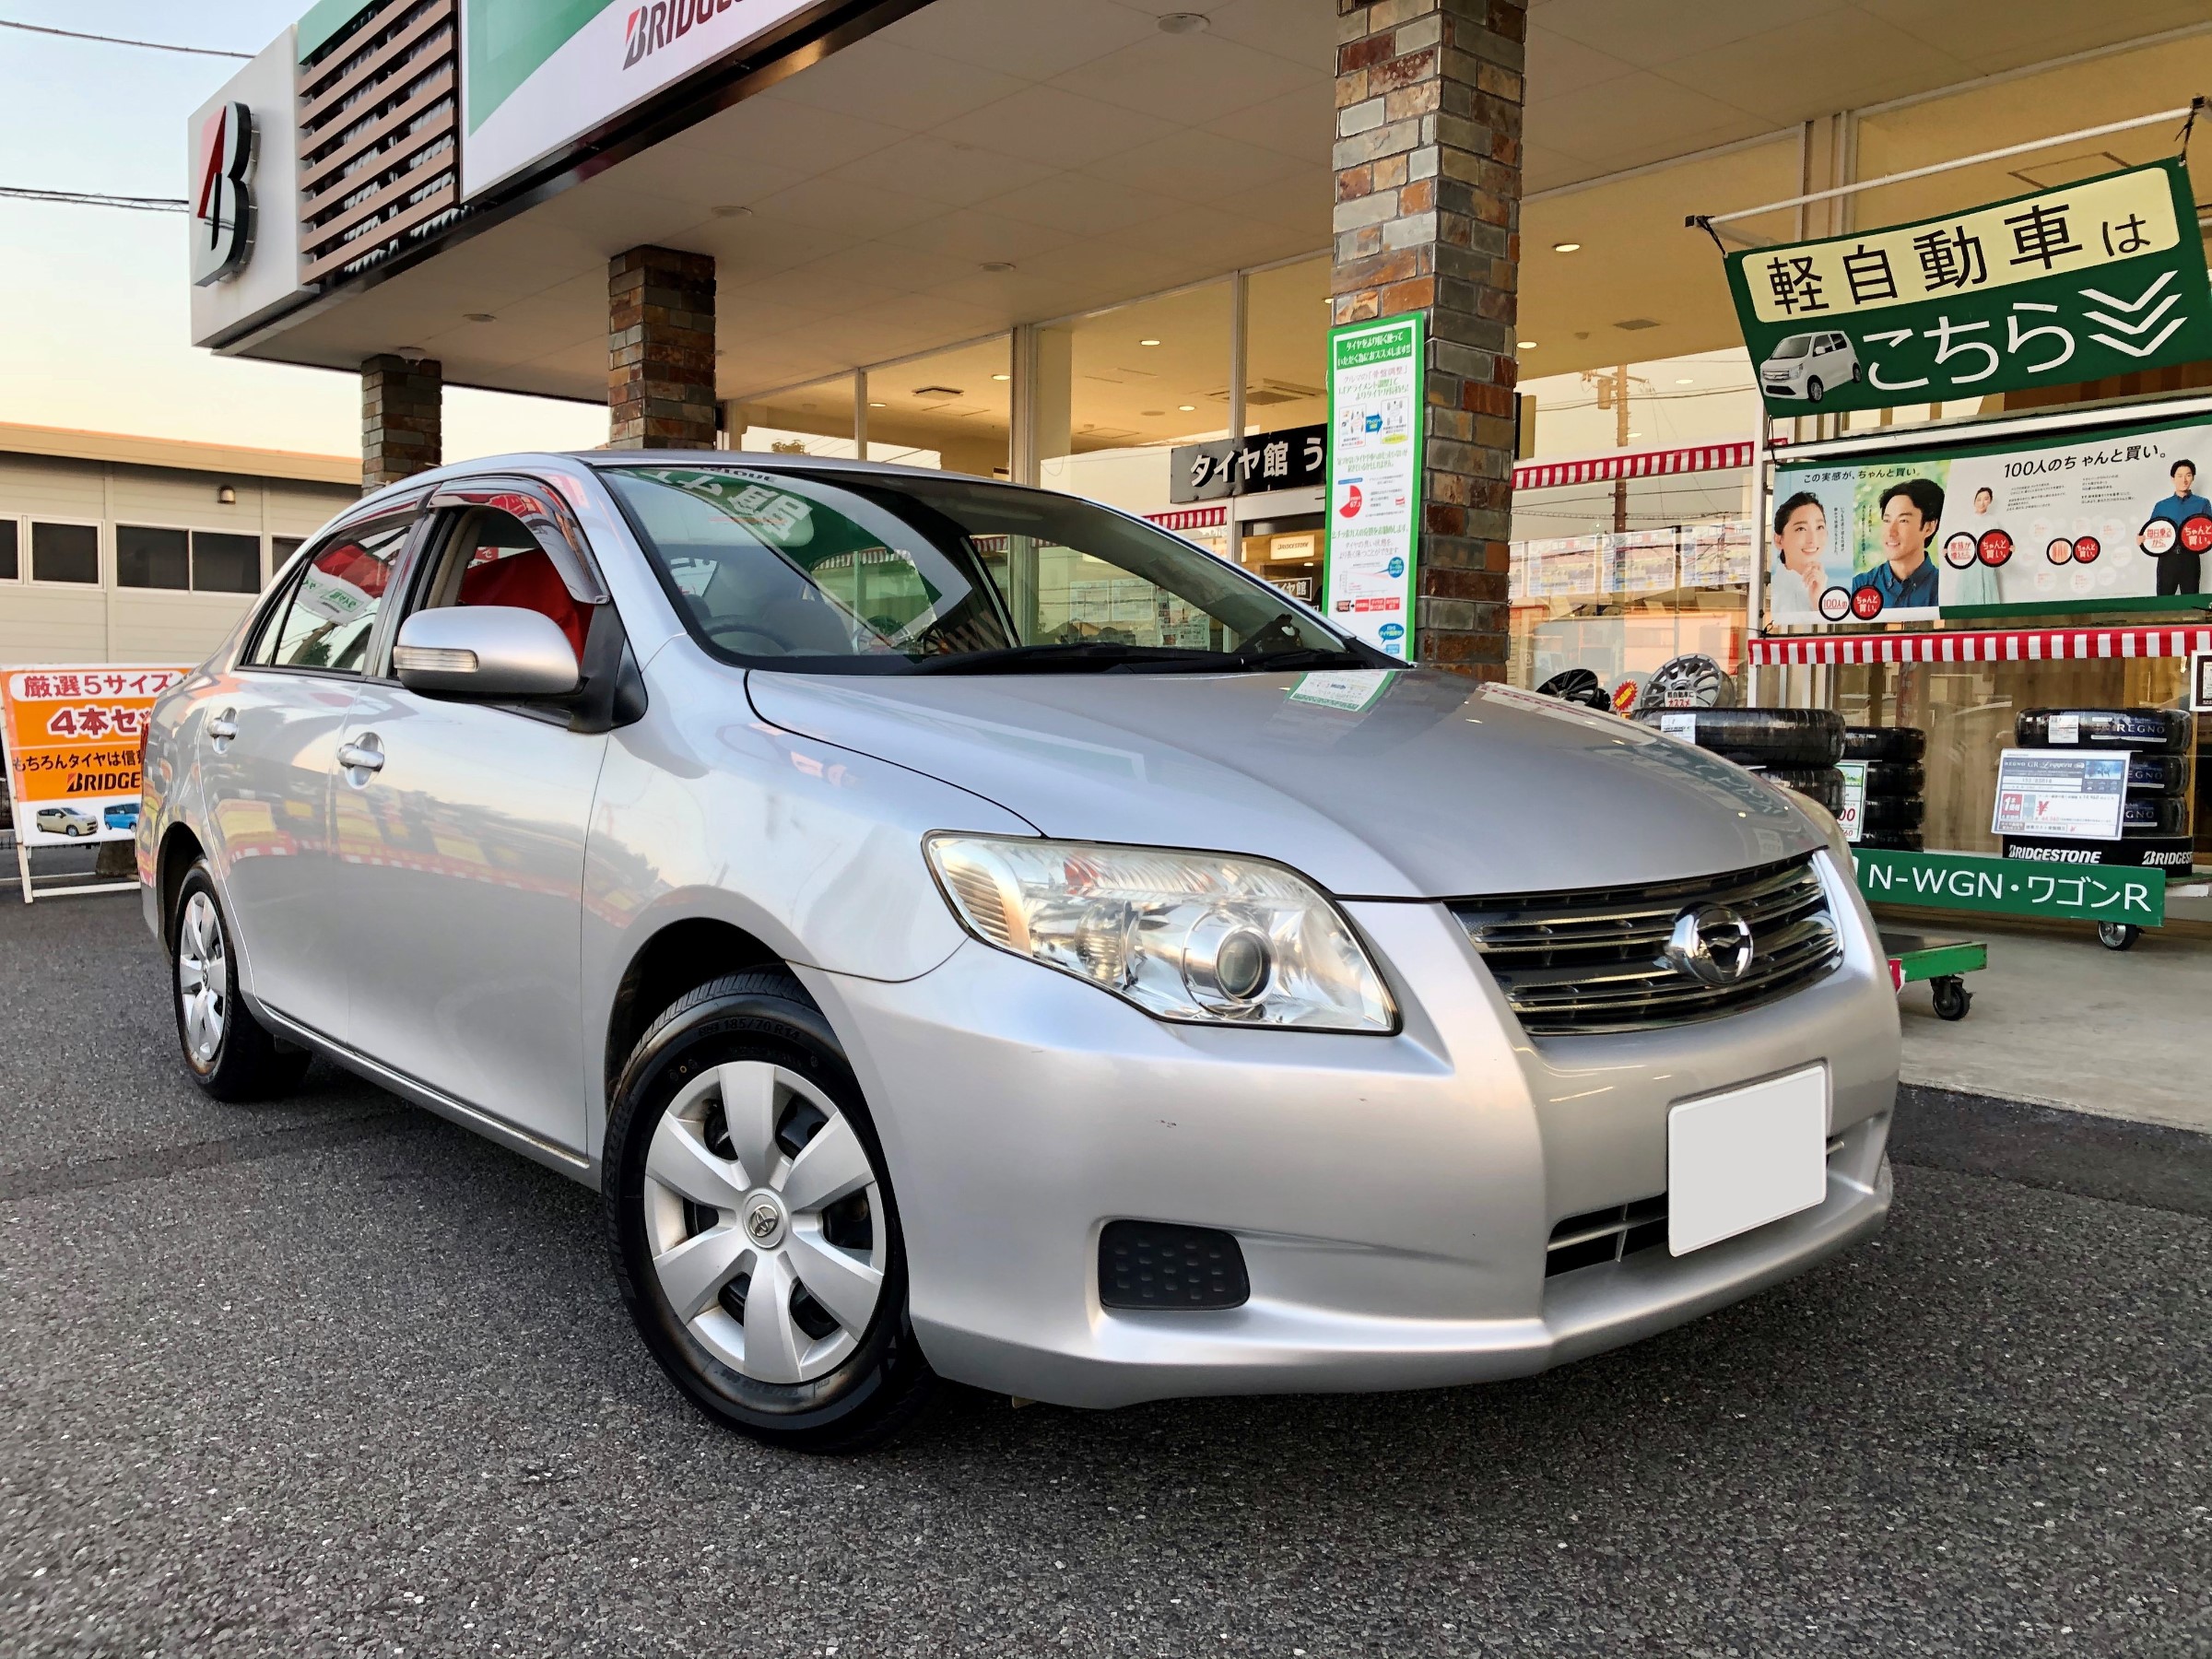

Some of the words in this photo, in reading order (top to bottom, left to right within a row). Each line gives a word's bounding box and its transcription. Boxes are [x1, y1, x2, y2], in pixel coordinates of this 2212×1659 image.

[623, 0, 743, 70] BRIDG
[1766, 203, 2151, 315] 軽自動車は
[1862, 301, 2076, 391] こちら
[1190, 441, 1288, 488] タイヤ館
[1303, 437, 1324, 472] う
[2184, 525, 2212, 536] ちゃんと
[1982, 540, 2006, 550] ちゃんと
[1855, 594, 1878, 605] ちゃんと
[24, 673, 173, 699] 厳選5サイズ
[2116, 723, 2165, 734] REGNO
[13, 750, 141, 772] もちろんタイヤは信
[2008, 844, 2102, 865] BRIDGESTONE
